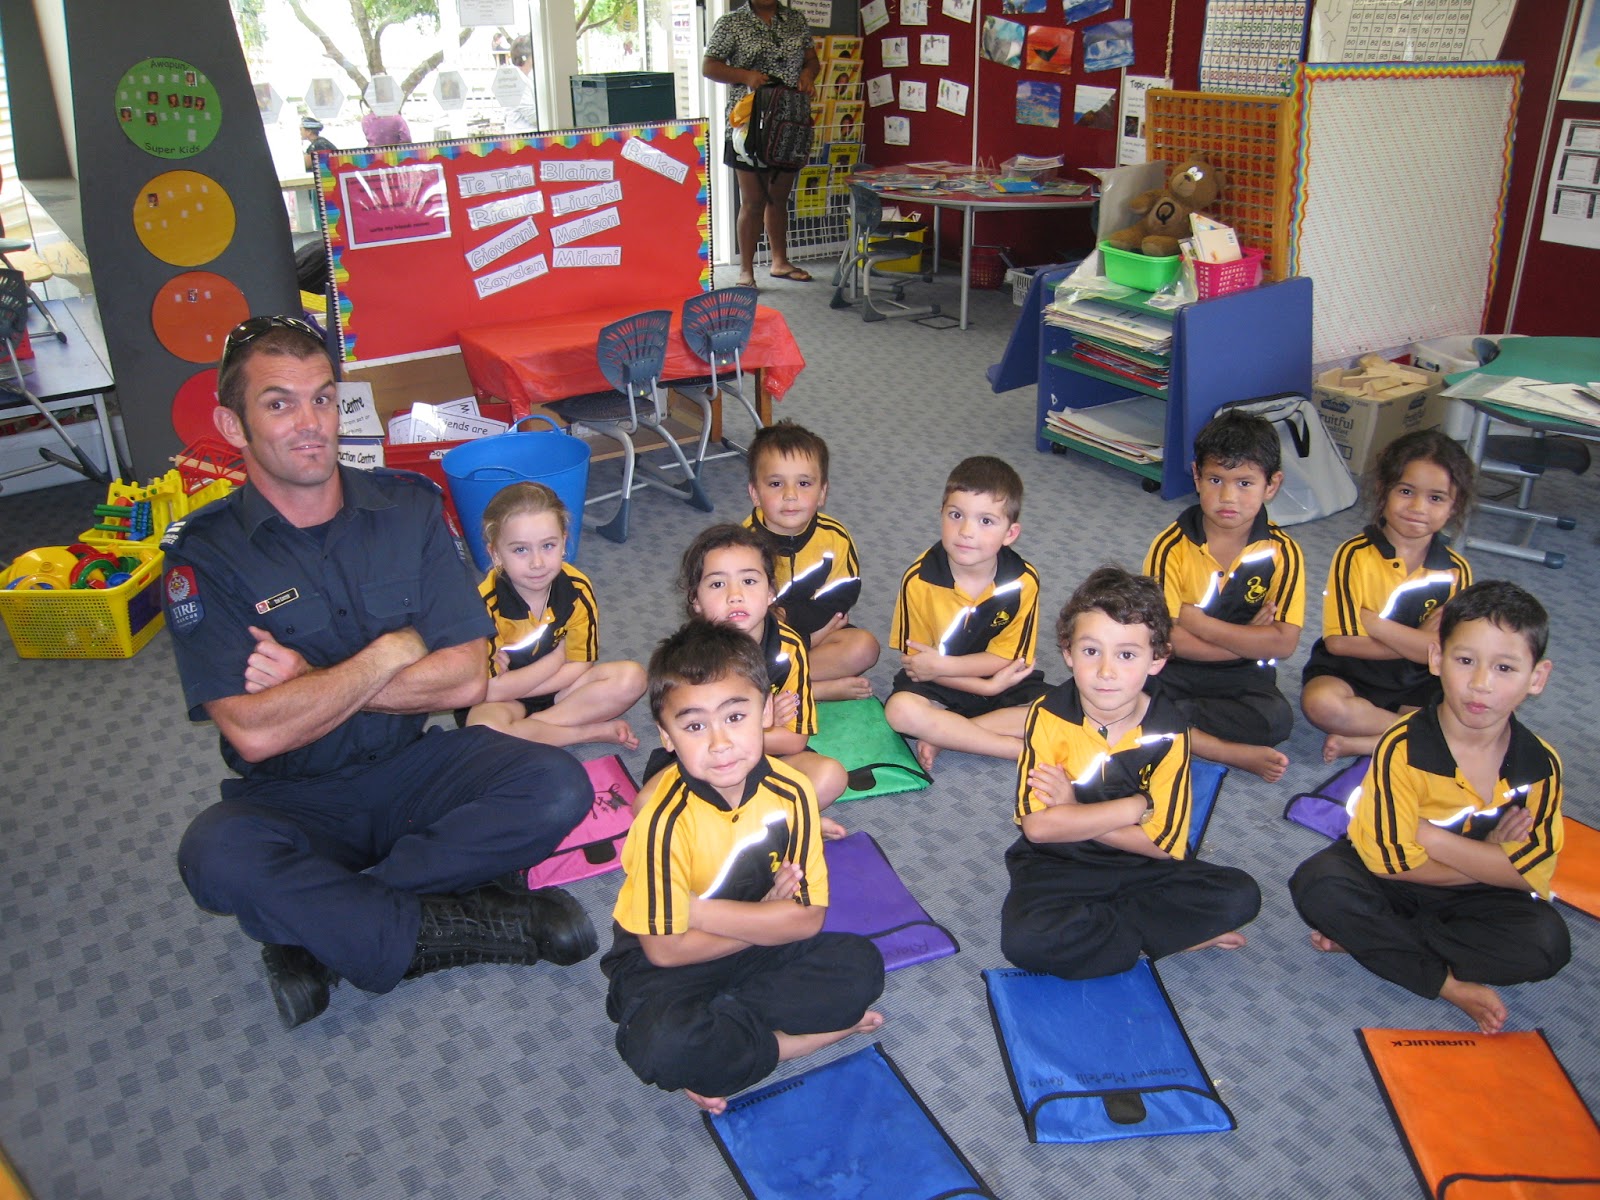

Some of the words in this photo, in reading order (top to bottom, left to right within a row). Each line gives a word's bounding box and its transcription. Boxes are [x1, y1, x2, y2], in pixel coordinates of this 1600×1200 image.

[1448, 13, 1457, 21] 68
[1460, 13, 1469, 21] 69
[1458, 27, 1465, 35] 79
[1130, 79, 1145, 90] Topic
[144, 142, 175, 154] Super
[180, 145, 200, 154] Kids
[625, 141, 687, 183] Rakai
[542, 163, 611, 180] Blaine
[461, 176, 486, 194] Te
[491, 170, 532, 189] Tiria
[554, 184, 621, 214] Liuaki
[472, 198, 540, 227] Riana
[1156, 202, 1175, 225] Q
[555, 213, 618, 245] Madison
[471, 222, 536, 268] Giovanni
[555, 249, 619, 267] Milani
[477, 259, 545, 293] Kayden
[342, 397, 365, 414] Centre
[445, 418, 470, 432] iends
[471, 426, 488, 435] are
[1318, 410, 1354, 430] ruitful
[337, 450, 356, 464] ruction
[357, 452, 376, 464] Centre
[173, 601, 198, 619] FIRE
[1390, 1039, 1476, 1048] WARWICK
